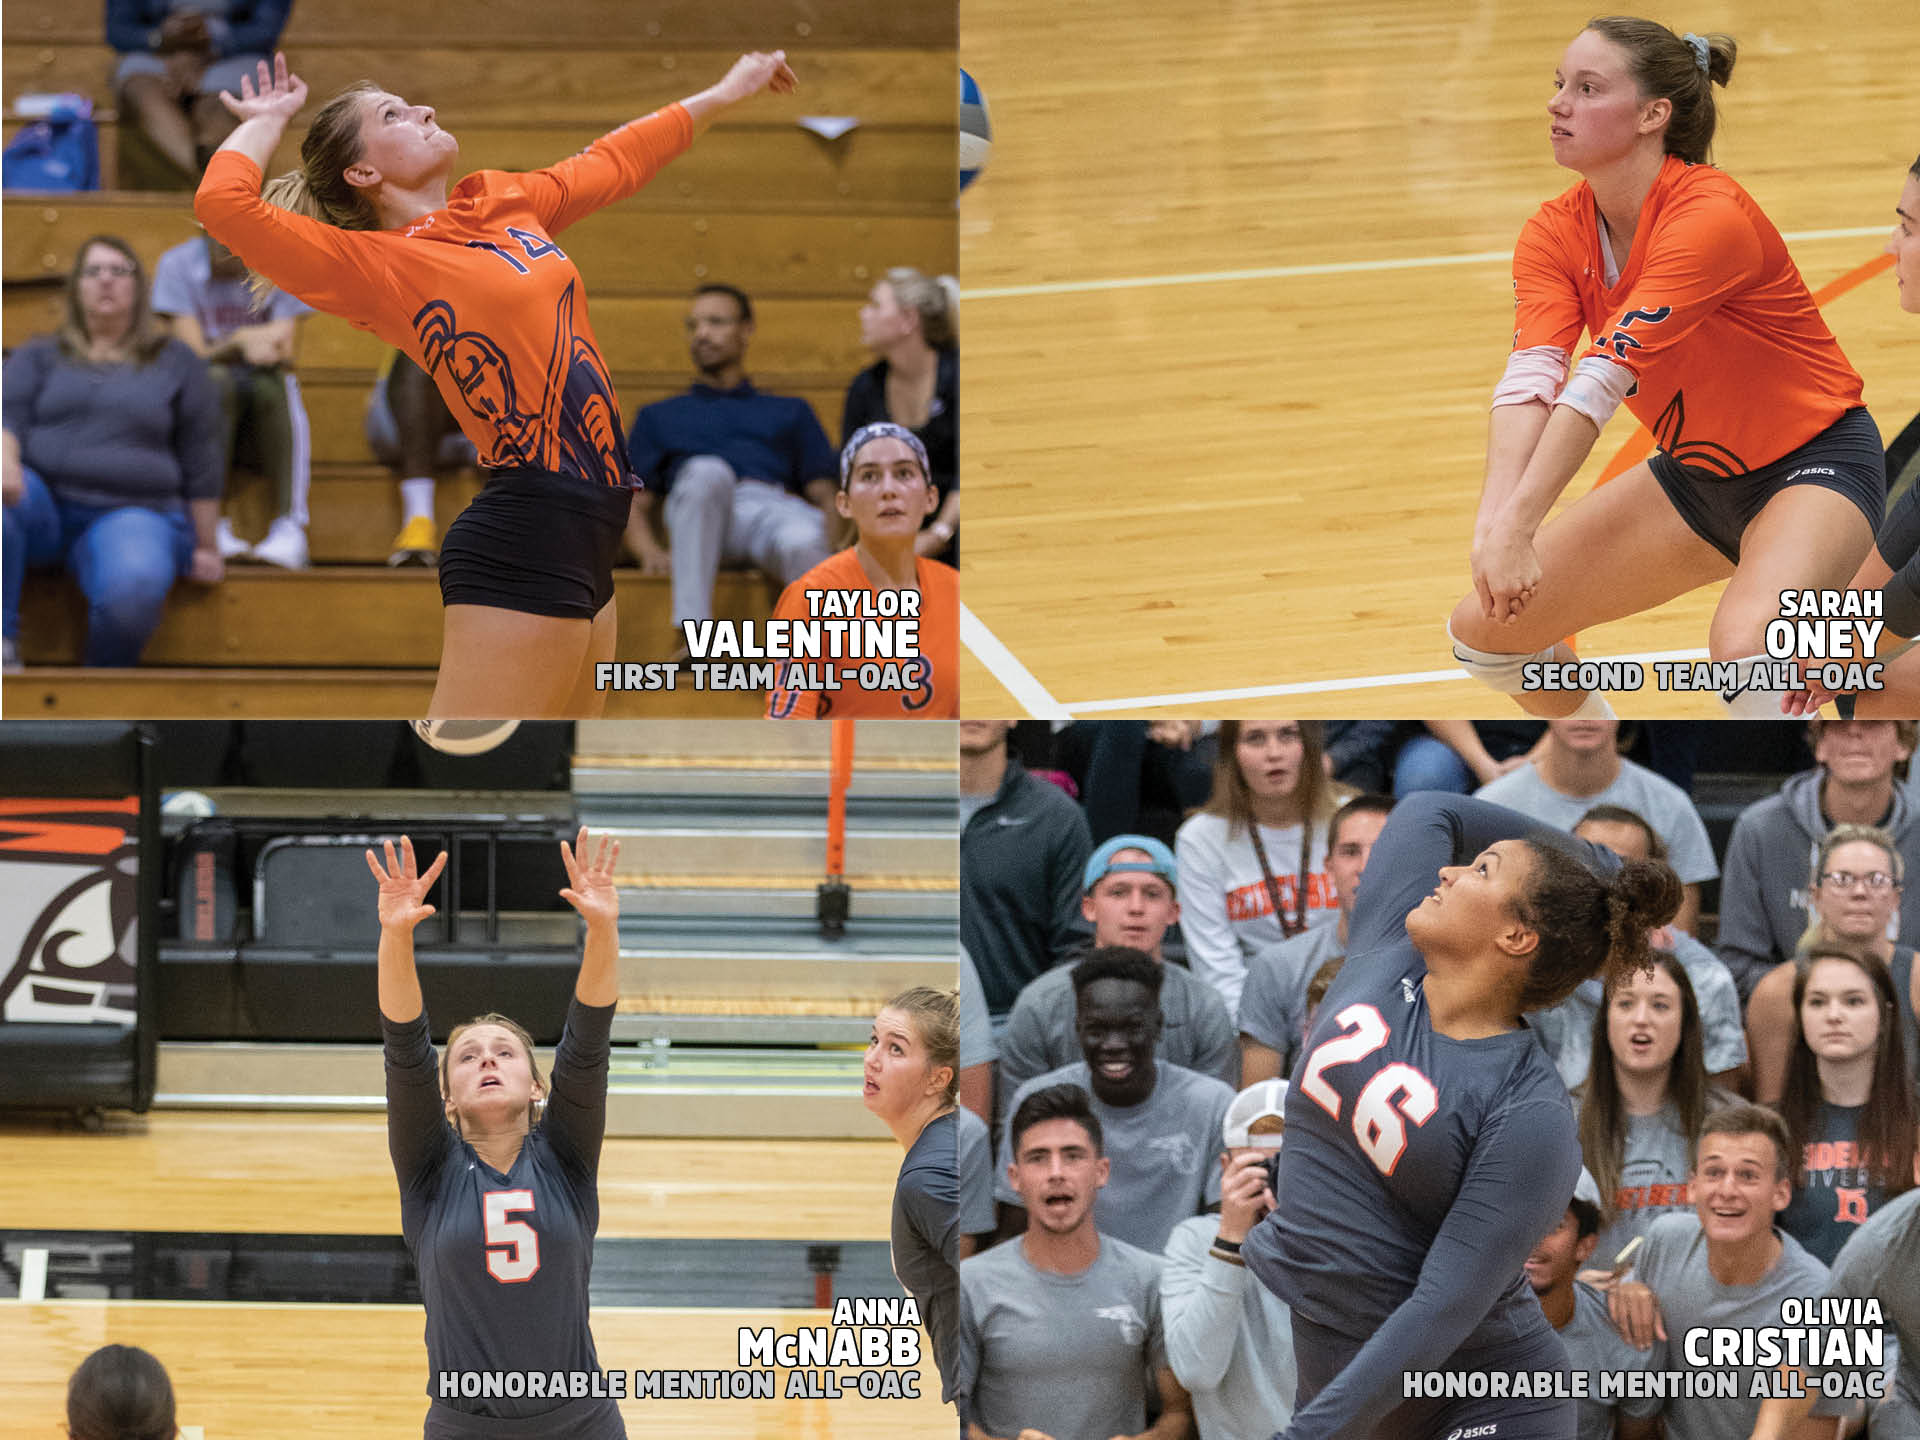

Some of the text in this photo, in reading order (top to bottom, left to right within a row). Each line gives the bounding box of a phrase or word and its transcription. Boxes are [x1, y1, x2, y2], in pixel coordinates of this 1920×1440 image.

[463, 224, 568, 275] 14
[1300, 1003, 1440, 1177] 26
[483, 1189, 541, 1284] 5
